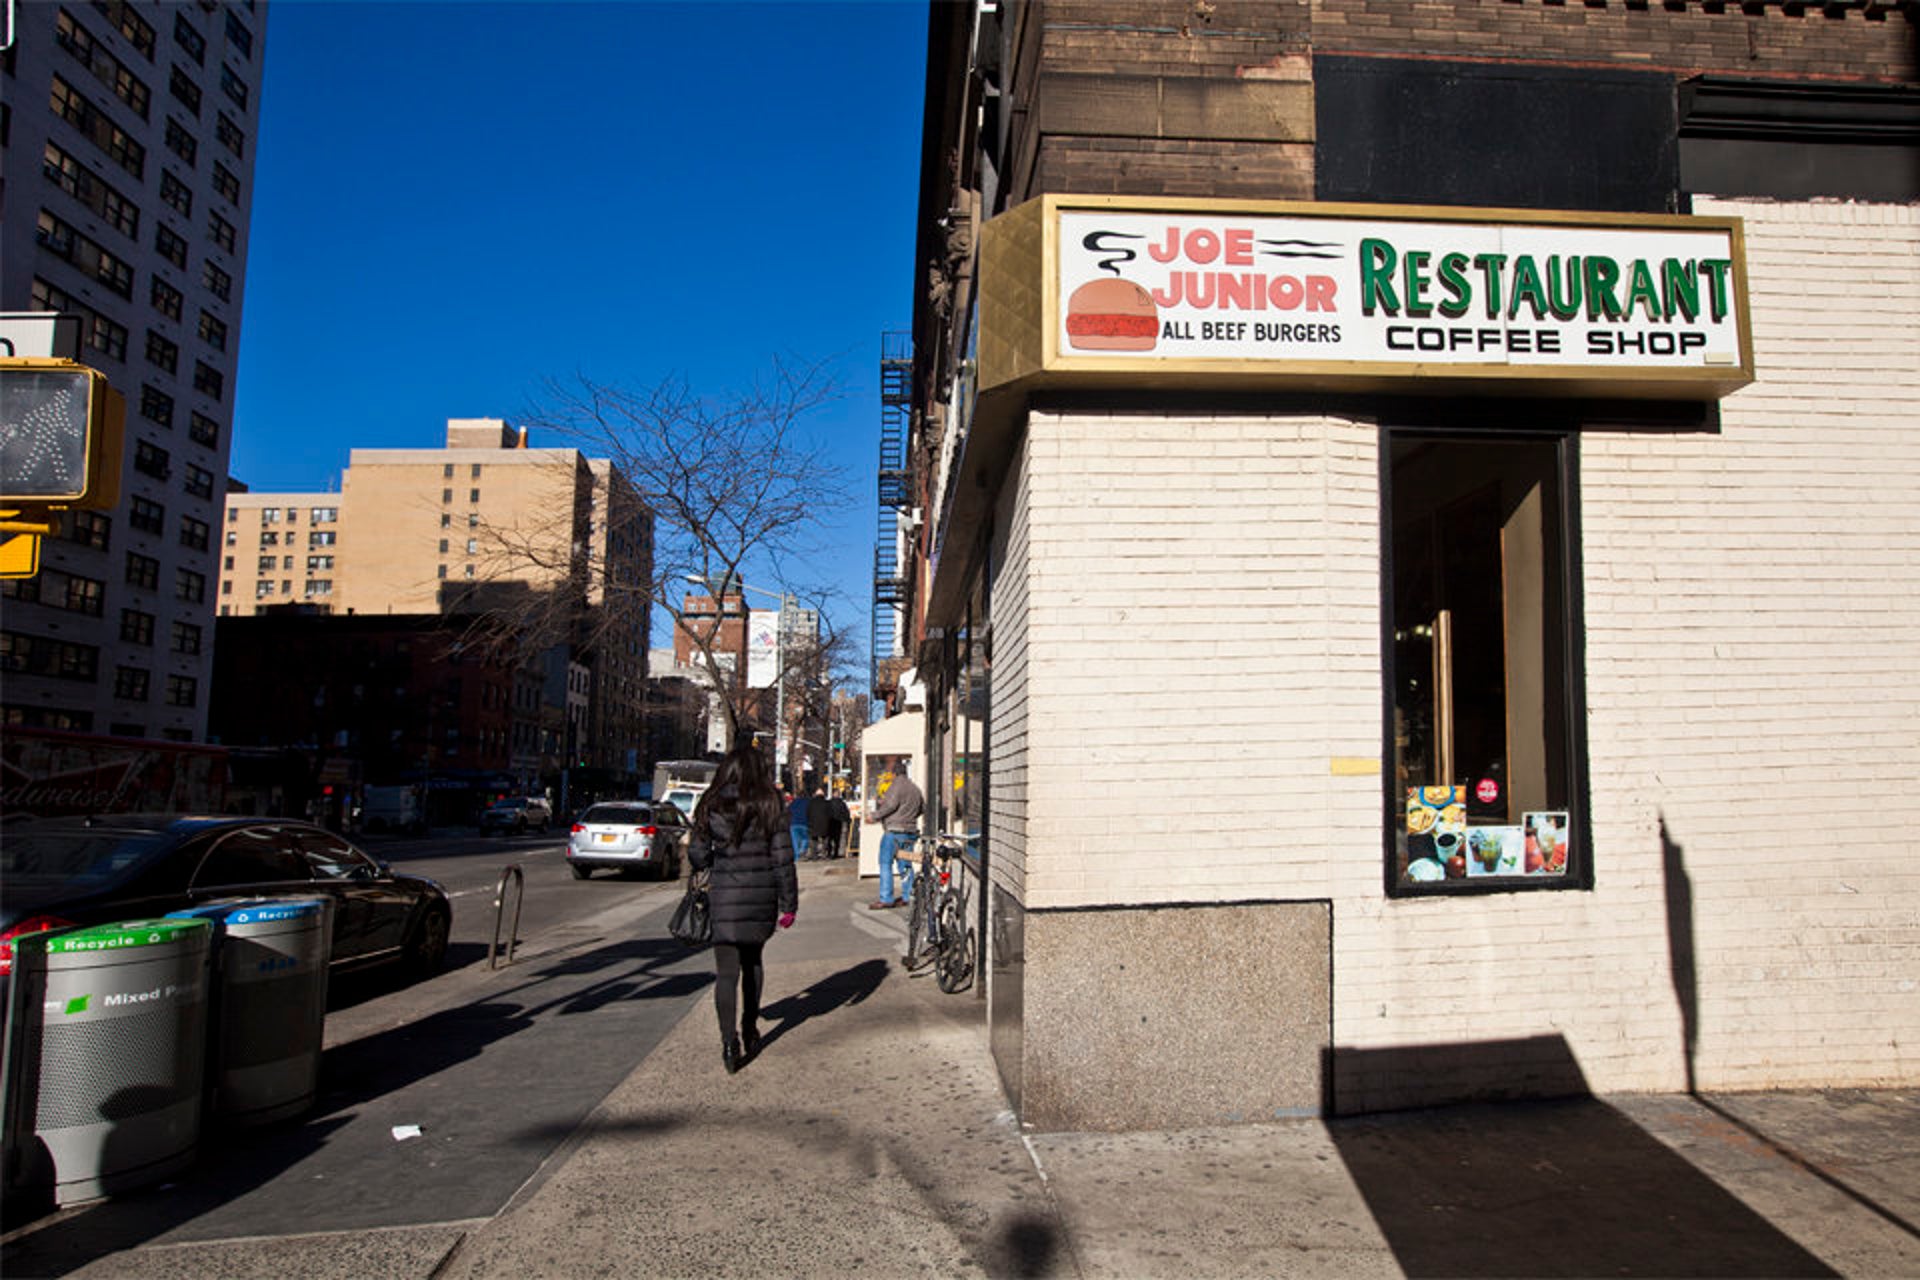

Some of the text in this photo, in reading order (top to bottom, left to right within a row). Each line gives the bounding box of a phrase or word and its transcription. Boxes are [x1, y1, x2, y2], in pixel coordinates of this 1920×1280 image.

[1148, 227, 1254, 266] JOE
[1151, 271, 1338, 313] JUNIOR
[1360, 237, 1732, 324] RESTAURANT
[1162, 321, 1342, 343] ALL BEEF BURGERS
[1386, 326, 1707, 356] COFFEE SHOP
[64, 935, 135, 950] Recycle
[104, 988, 161, 1007] Mixed
